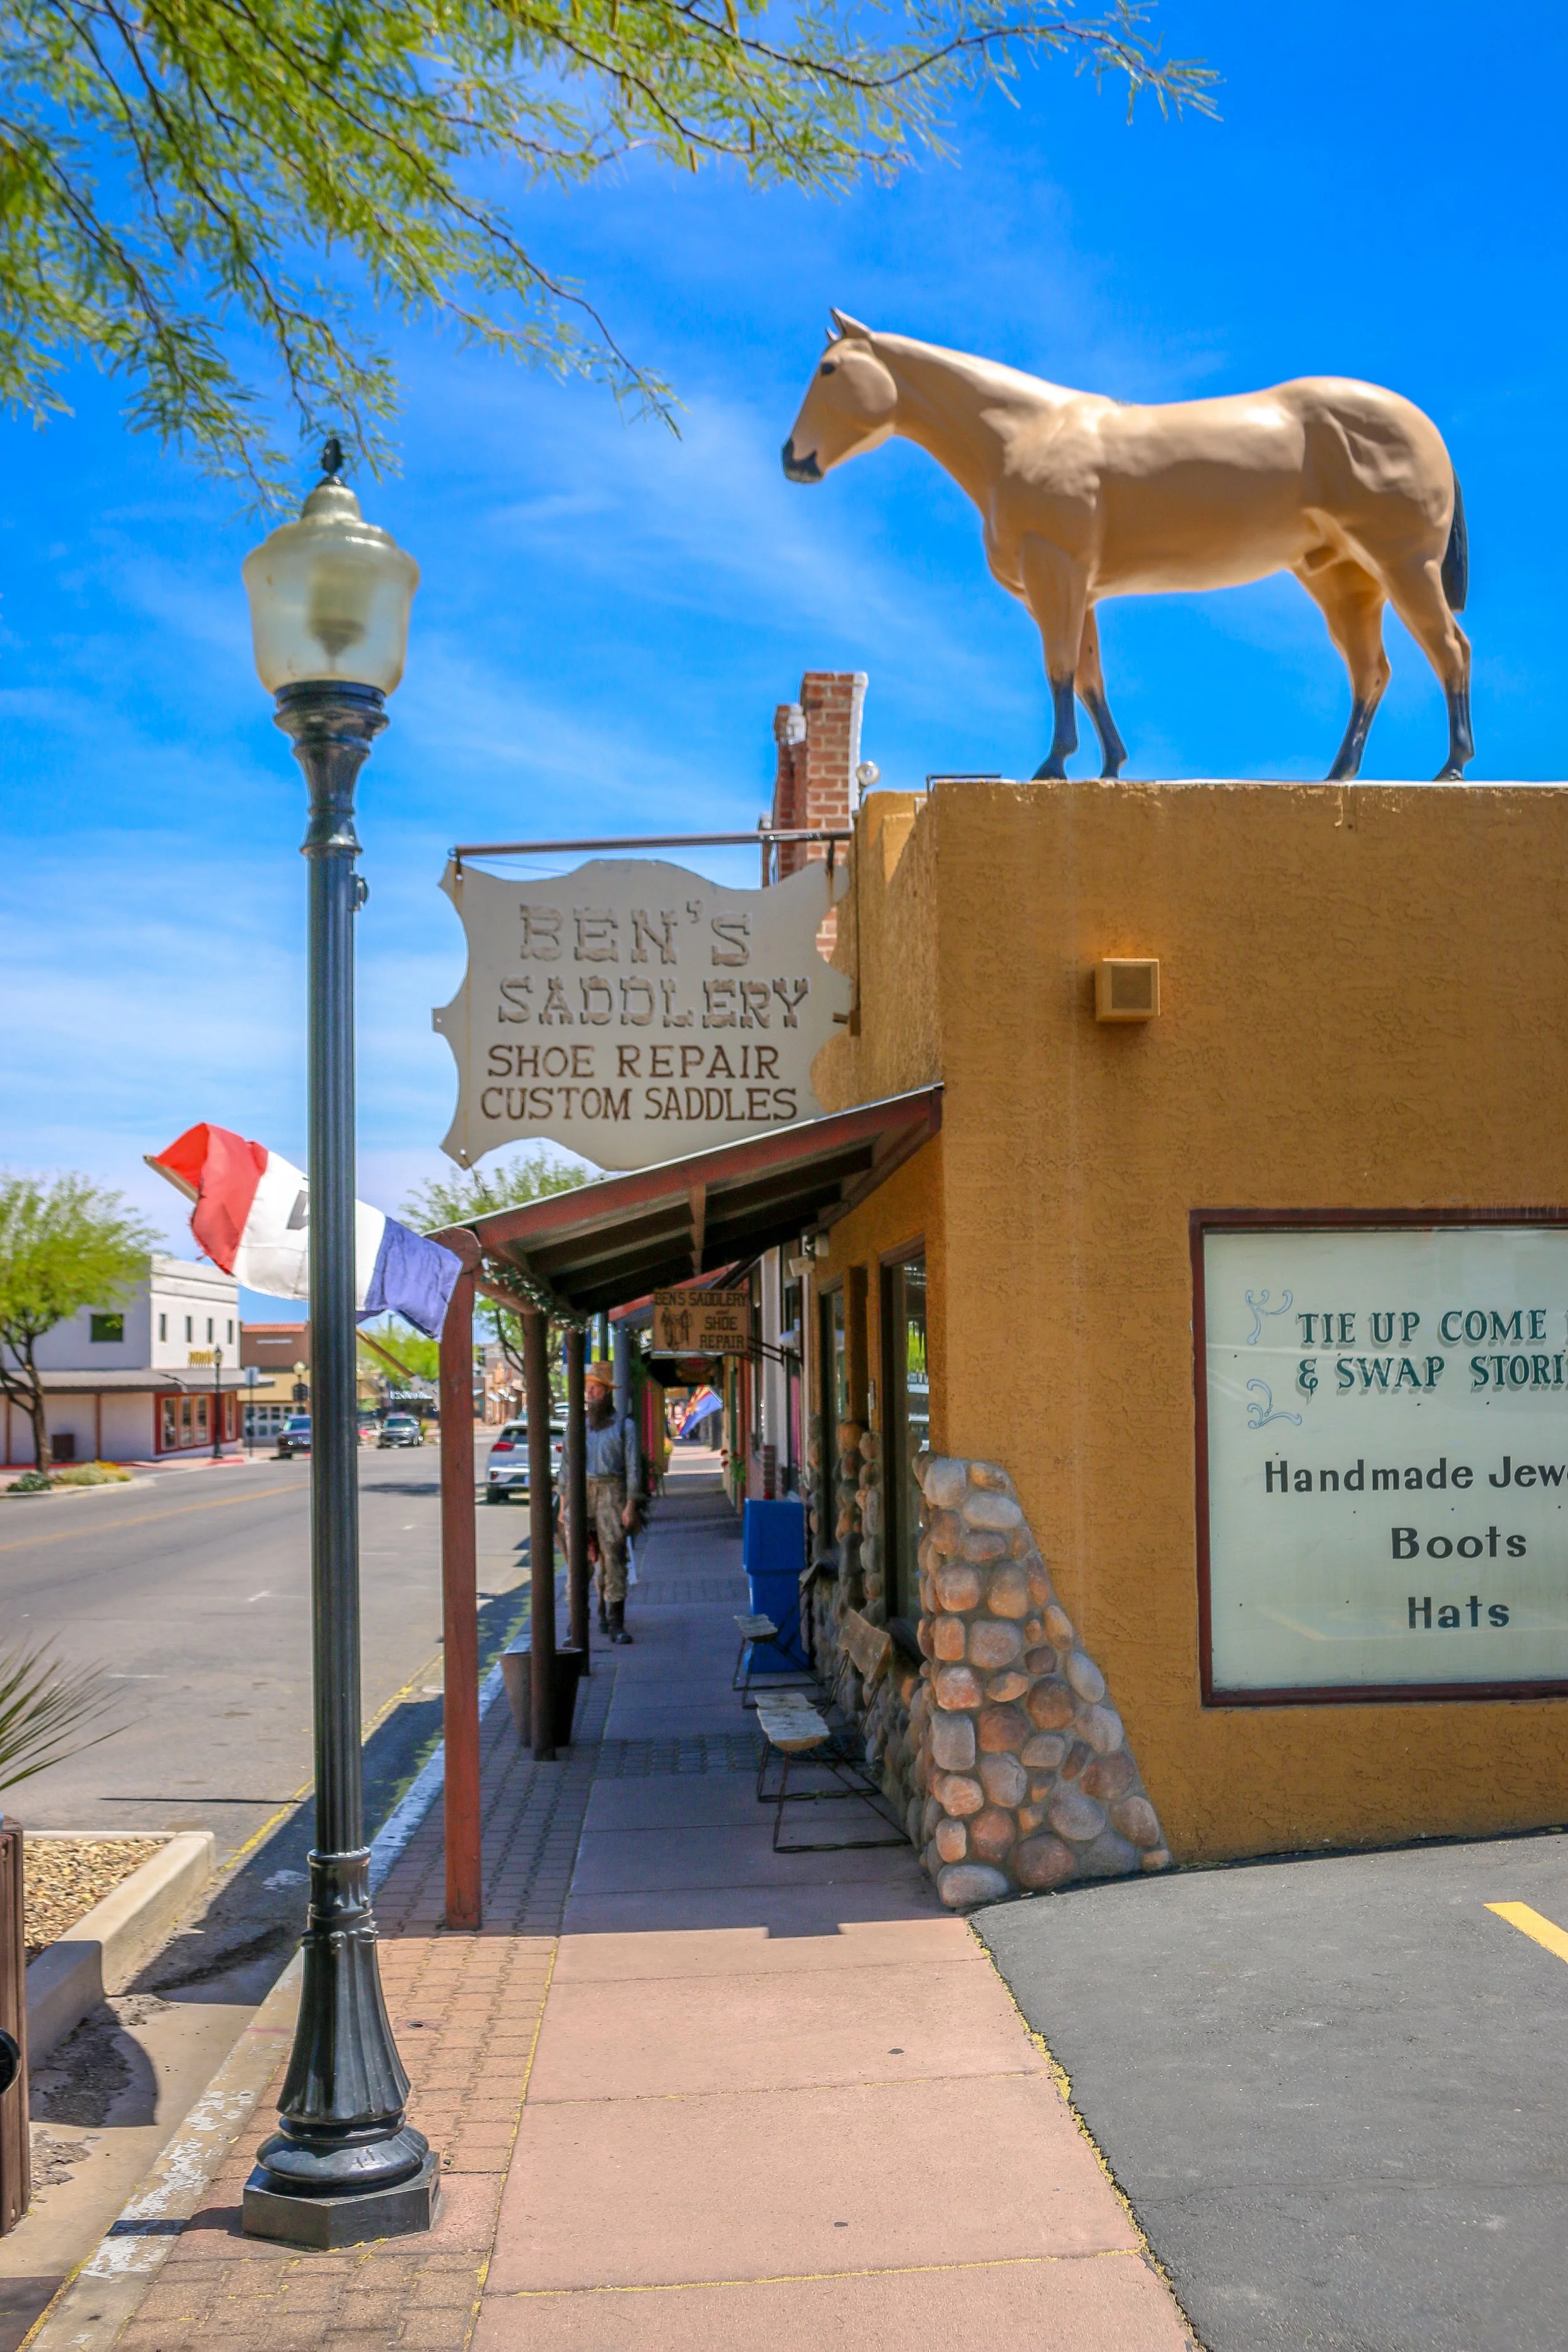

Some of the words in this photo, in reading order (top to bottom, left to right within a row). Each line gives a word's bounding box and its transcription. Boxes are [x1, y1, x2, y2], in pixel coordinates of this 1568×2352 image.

[519, 900, 754, 967] BEN'S
[498, 975, 810, 1029] SADDLERY
[487, 1044, 595, 1078] SHOE
[617, 1044, 780, 1079] REPAIR
[480, 1087, 632, 1122] CUSTOM
[644, 1087, 798, 1121] SADDLES
[687, 1291, 748, 1306] SADDLERY
[704, 1316, 738, 1330] SHOE
[1297, 1311, 1357, 1345] TIE
[1369, 1310, 1421, 1345] UP
[1439, 1308, 1547, 1345] COME
[698, 1334, 744, 1350] REPAIR
[1298, 1358, 1318, 1394] &
[1338, 1355, 1444, 1390] SWAP
[1470, 1354, 1568, 1389] STORI
[1265, 1458, 1474, 1493] Handmade
[1488, 1455, 1568, 1488] Jew
[1391, 1525, 1527, 1560] Boots
[1407, 1595, 1510, 1629] Hats
